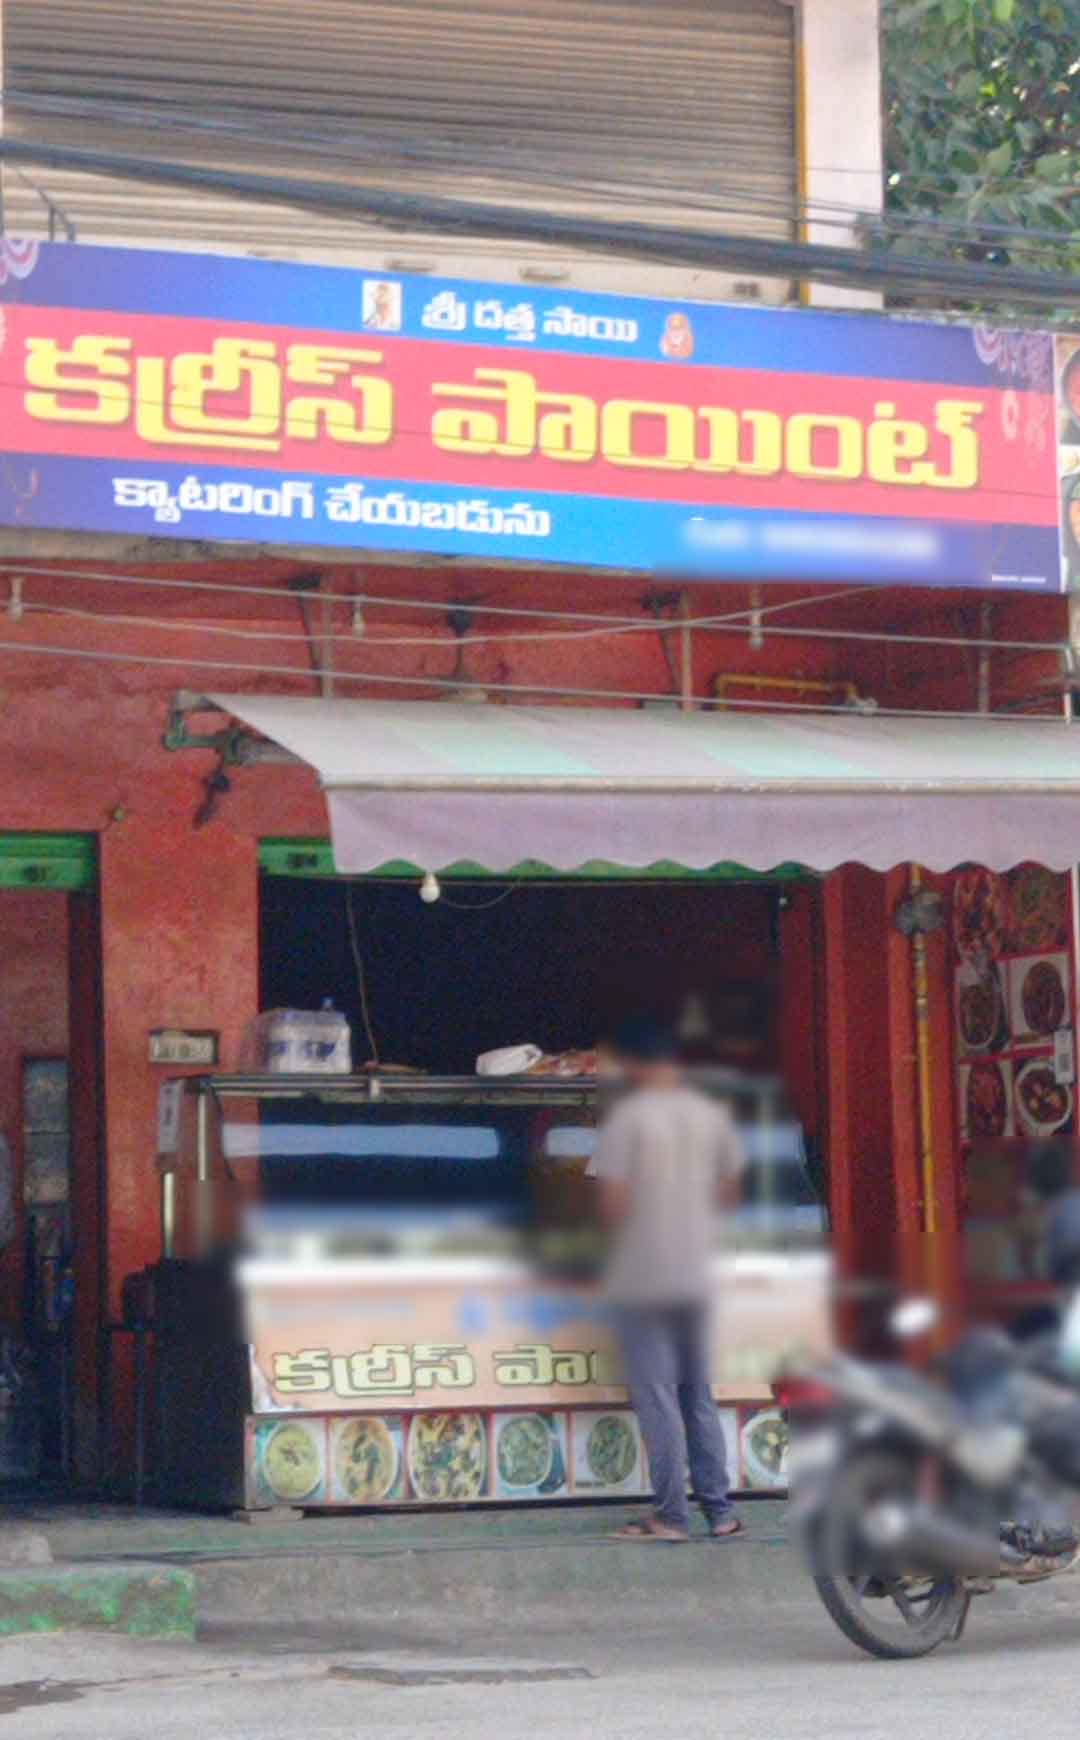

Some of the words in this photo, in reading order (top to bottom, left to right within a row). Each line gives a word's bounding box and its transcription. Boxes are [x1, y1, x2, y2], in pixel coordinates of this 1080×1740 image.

[421, 291, 467, 331] శ్రీ
[473, 299, 537, 342] దత్త
[543, 305, 639, 343] సాయి
[24, 335, 394, 452] కర్రీస్
[431, 367, 984, 489] పాయింట్
[112, 475, 315, 524] క్యాటరింగ్
[324, 482, 551, 537] చేయబడును
[272, 1344, 475, 1398] కర్రీస్
